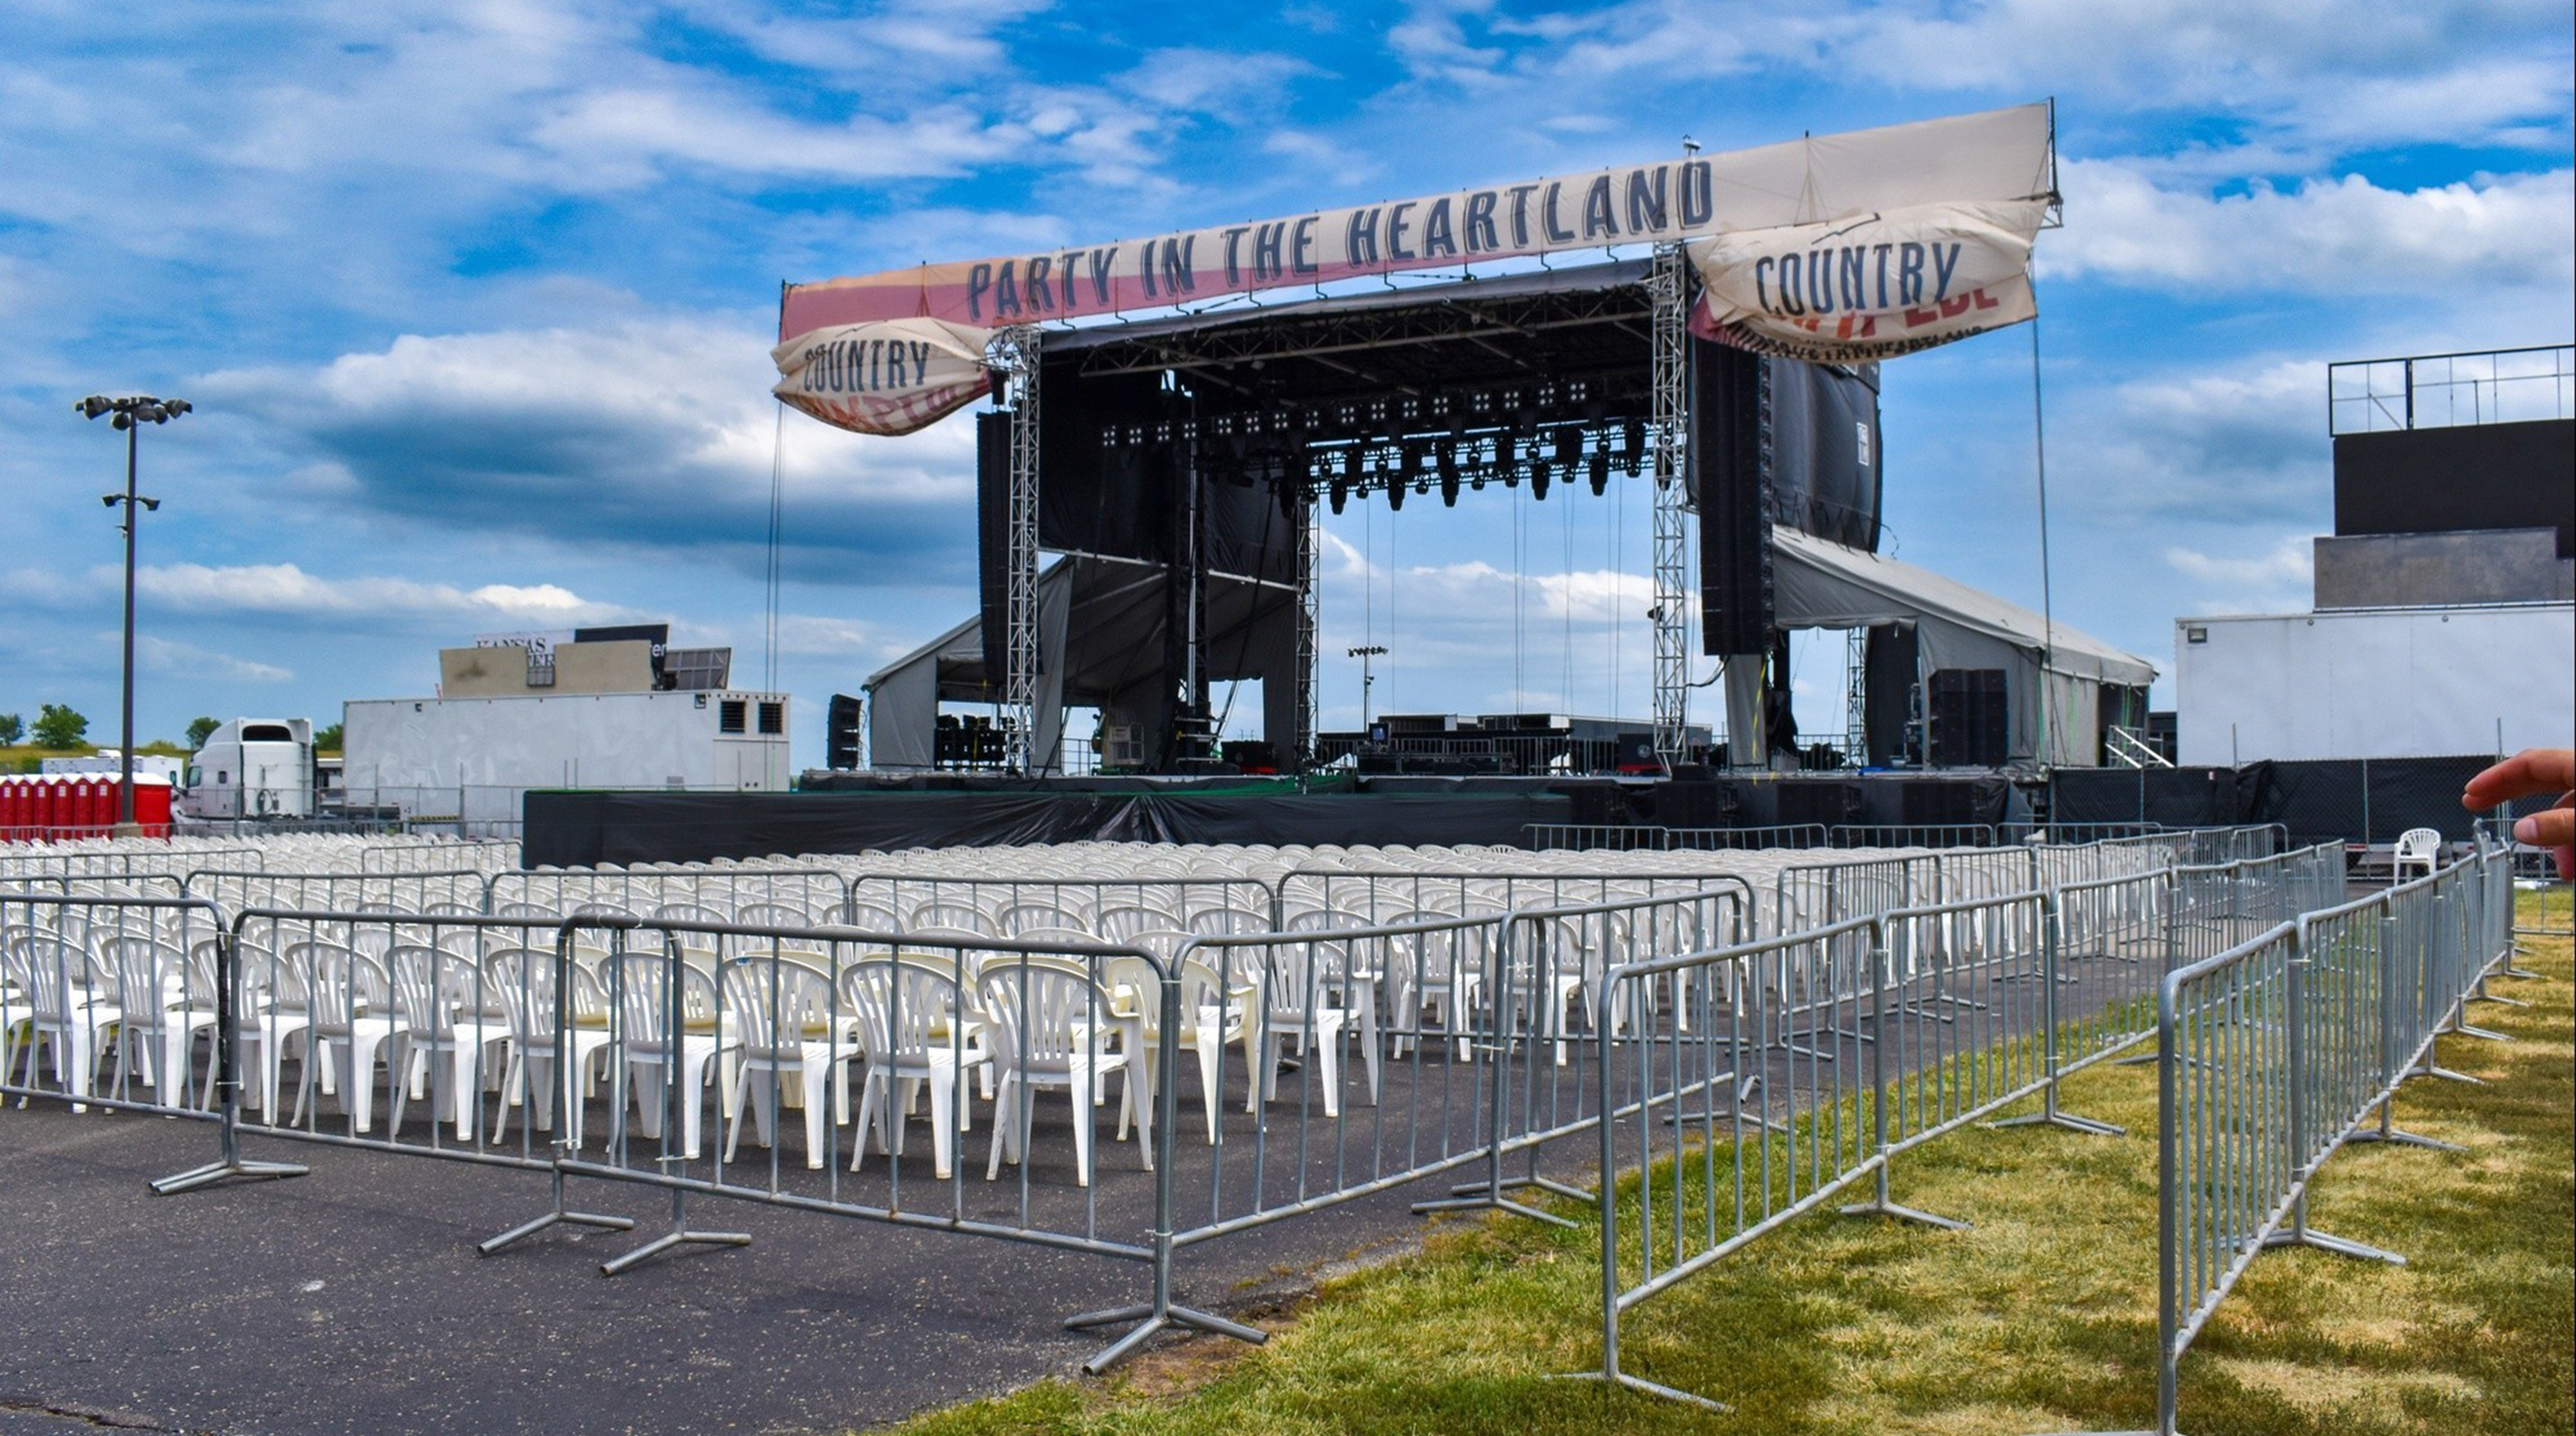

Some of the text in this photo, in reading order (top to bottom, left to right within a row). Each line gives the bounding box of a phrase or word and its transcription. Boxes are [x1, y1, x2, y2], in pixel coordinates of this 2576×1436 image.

[967, 160, 1713, 322] PARTY IN THE HEARTLAND
[1755, 242, 1961, 316] COUNTRY
[803, 339, 930, 393] COUNTRY
